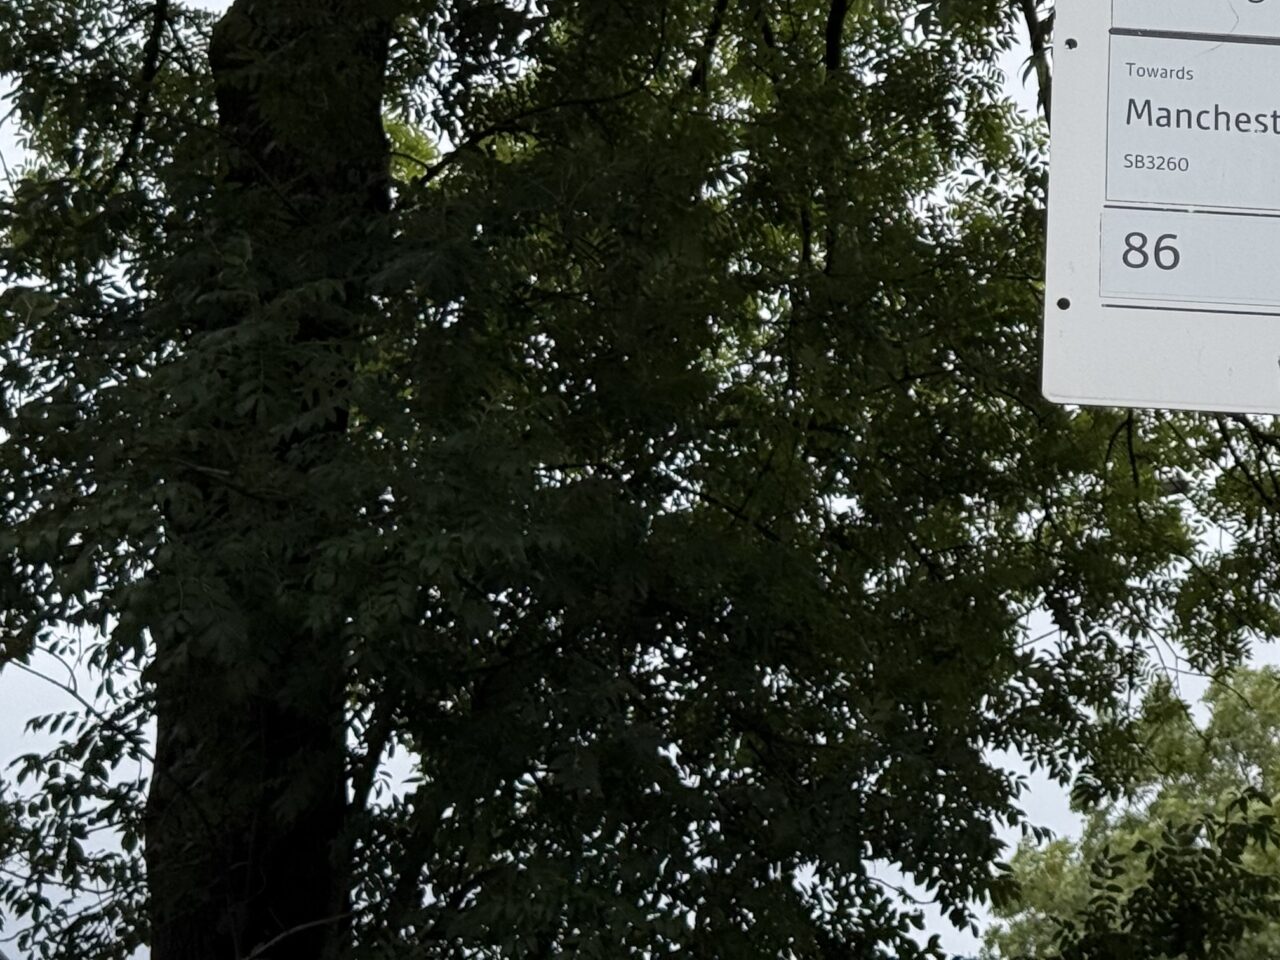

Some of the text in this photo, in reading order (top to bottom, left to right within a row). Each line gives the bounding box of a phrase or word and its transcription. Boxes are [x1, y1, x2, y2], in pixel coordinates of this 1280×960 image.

[1125, 62, 1194, 81] Towards
[1123, 153, 1189, 172] SB3260
[1122, 231, 1181, 271] 86
